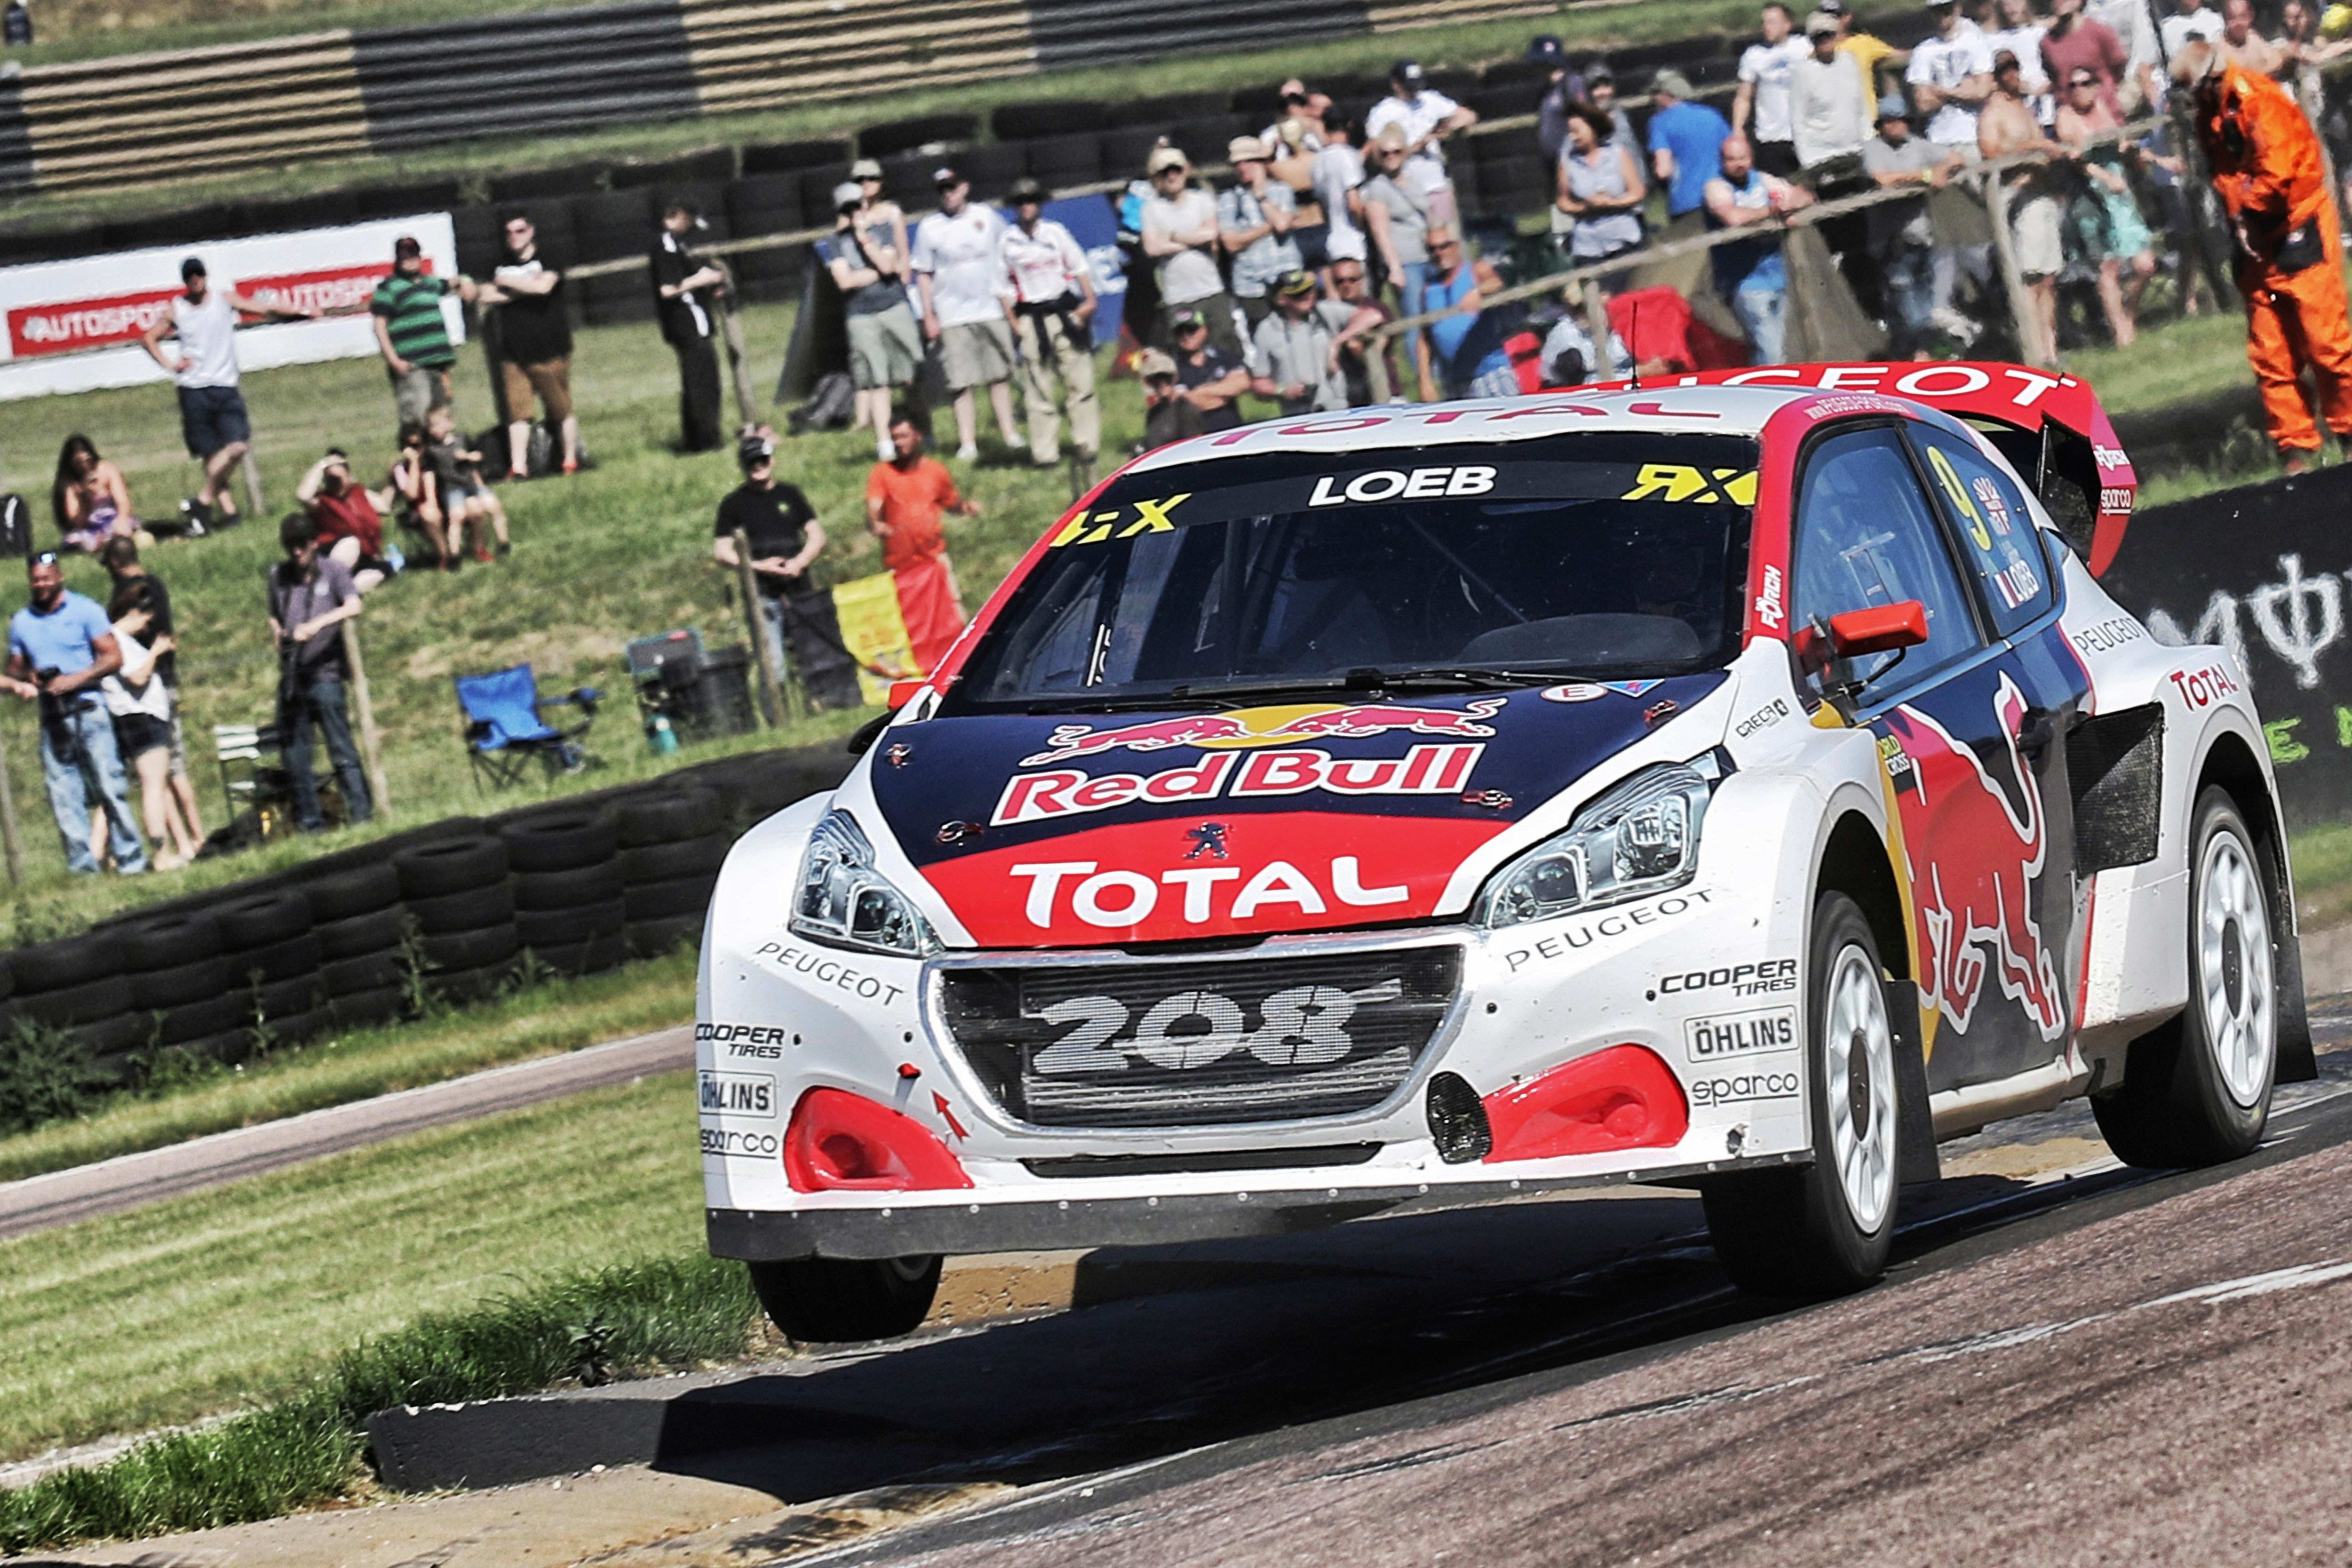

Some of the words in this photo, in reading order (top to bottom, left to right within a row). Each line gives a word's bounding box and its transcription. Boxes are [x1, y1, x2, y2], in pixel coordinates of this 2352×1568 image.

[37, 300, 169, 342] AUTOSPO
[1197, 403, 1720, 446] TOTAL
[1309, 466, 1496, 507] LOEB
[1927, 446, 1991, 551] 9
[2101, 489, 2131, 517] sparco
[2073, 617, 2146, 657] PEUGEOT
[2169, 663, 2239, 711] TOTAL
[990, 750, 1243, 827] Red
[1229, 742, 1486, 796] Bull
[1009, 856, 1409, 929] TOTAL
[1504, 888, 1714, 973] PEUGEOT
[755, 941, 904, 1006] PEUGEOT
[1660, 958, 1797, 995] COOPER
[1732, 977, 1797, 997] TIRES
[695, 1023, 785, 1045] COOPER
[1033, 985, 1357, 1074] 208
[1695, 1018, 1792, 1054] ÖHLINS
[729, 1044, 782, 1059] TIRES
[701, 1074, 769, 1111] ÖHLINS
[1692, 1074, 1799, 1106] sparco
[701, 1129, 778, 1153] sparco
